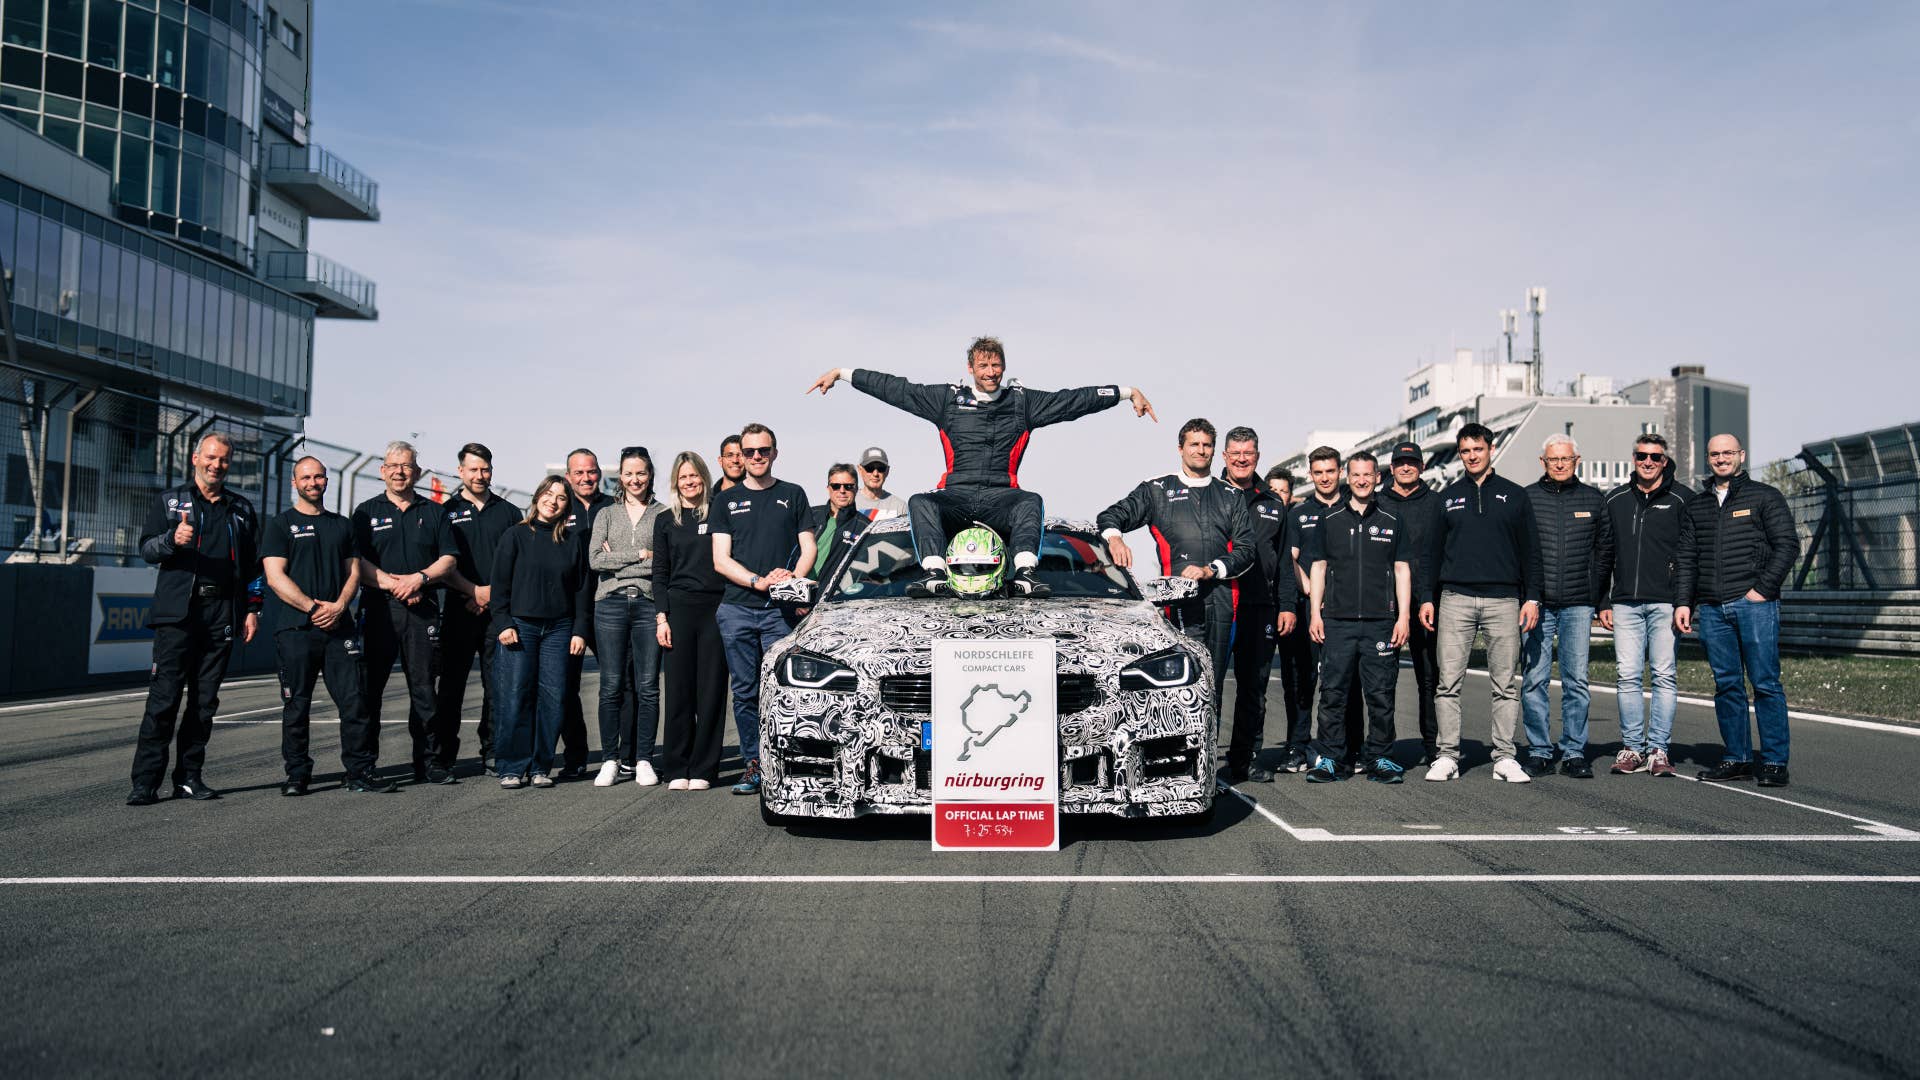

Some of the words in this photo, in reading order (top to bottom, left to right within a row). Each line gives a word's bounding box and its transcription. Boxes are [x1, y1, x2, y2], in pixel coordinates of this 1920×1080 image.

[954, 650, 1034, 660] NORDSCHLEIFE
[962, 664, 1003, 672] COMPACT
[1004, 664, 1026, 672] CARS
[944, 772, 1045, 791] nürburgring
[945, 810, 994, 820] OFFICIAL
[996, 810, 1017, 820] LAP
[1018, 810, 1045, 820] TIME
